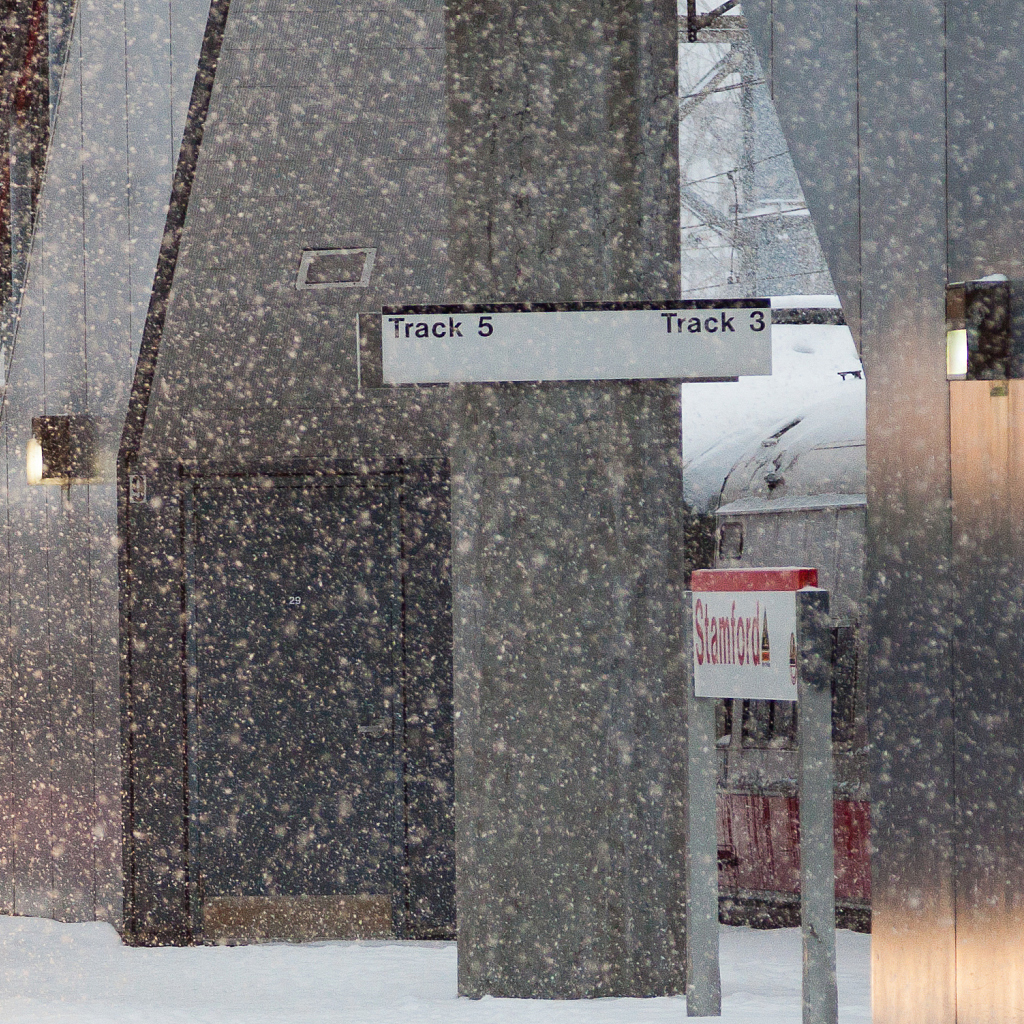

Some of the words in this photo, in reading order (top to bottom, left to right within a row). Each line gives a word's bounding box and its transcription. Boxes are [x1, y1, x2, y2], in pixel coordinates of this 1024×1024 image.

[388, 316, 464, 339] Track
[477, 315, 494, 338] 5
[661, 311, 736, 334] Track
[749, 310, 766, 333] 3
[695, 598, 761, 667] Stamford
